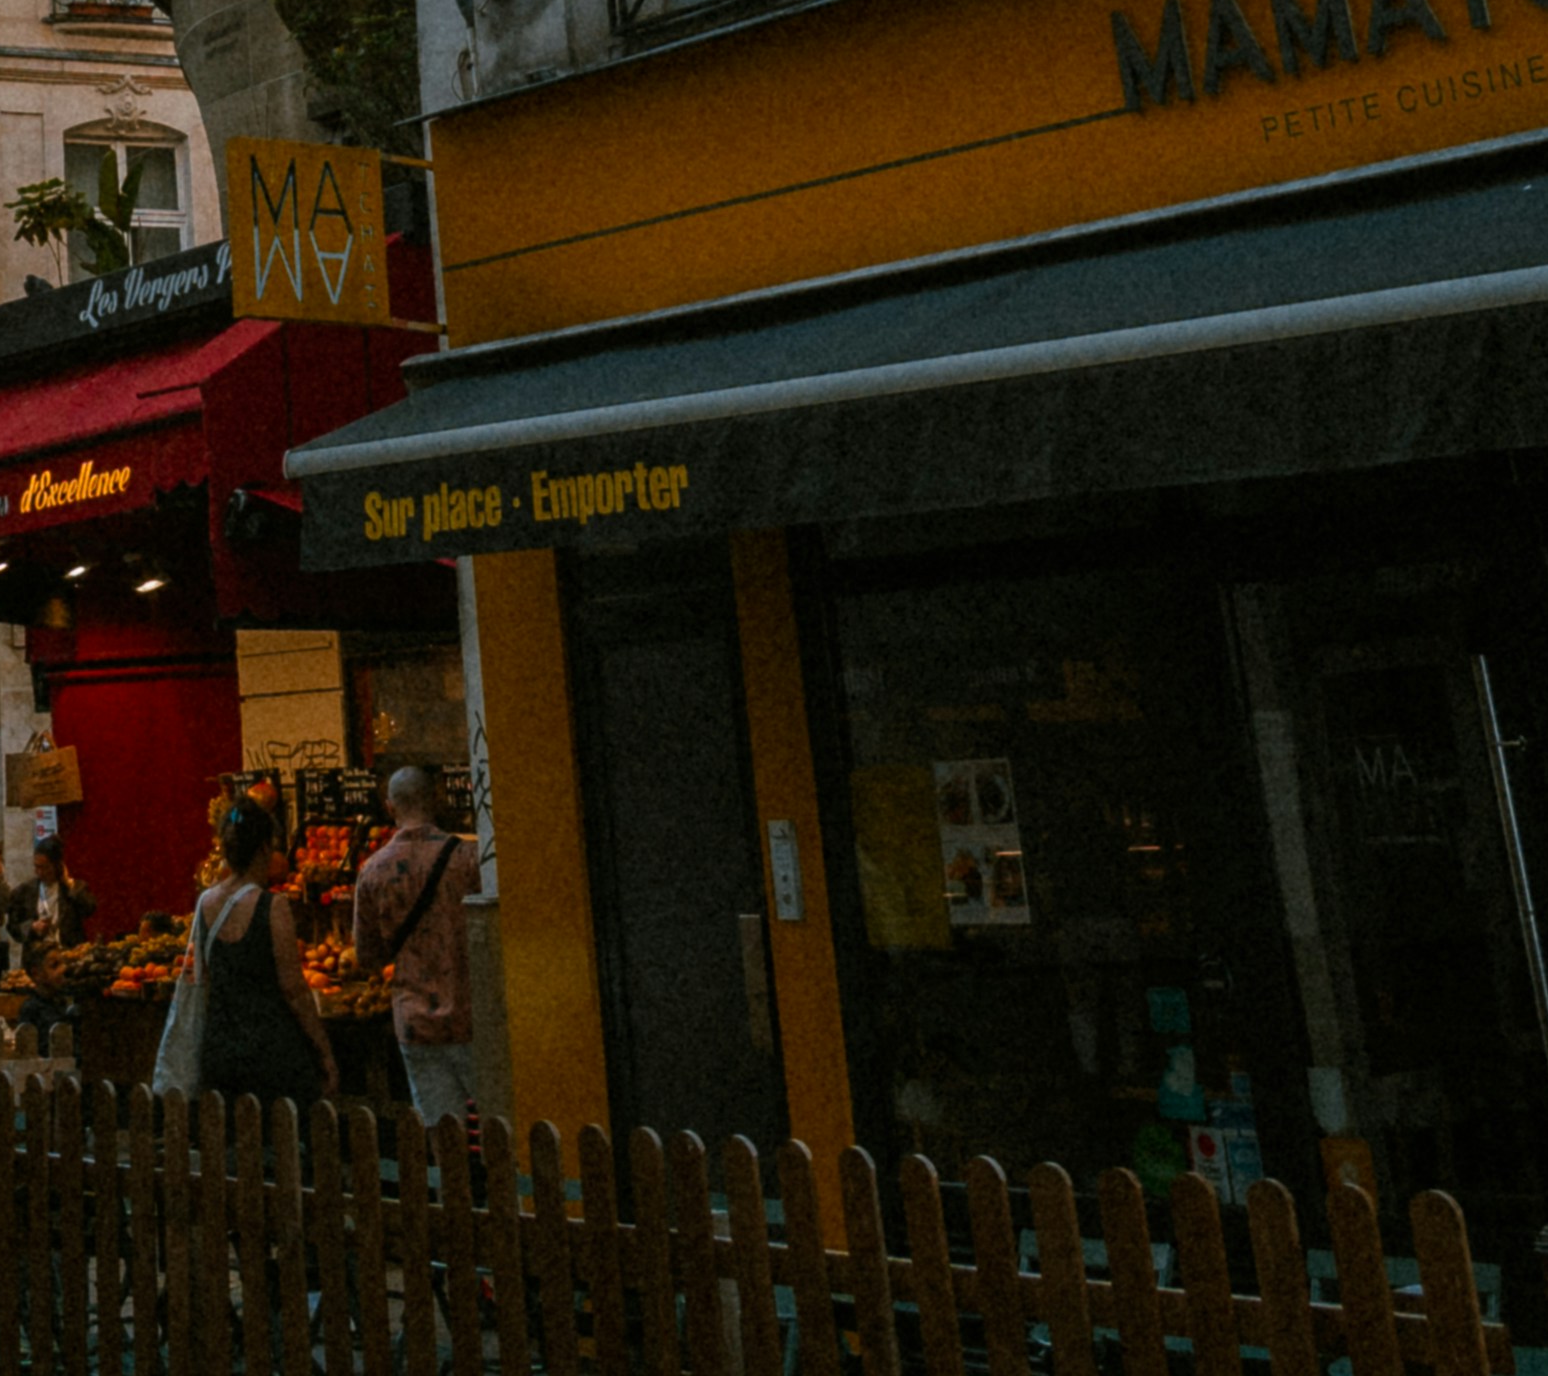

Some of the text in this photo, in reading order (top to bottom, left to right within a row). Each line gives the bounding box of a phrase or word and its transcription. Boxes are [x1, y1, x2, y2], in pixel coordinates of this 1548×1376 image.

[1260, 90, 1381, 142] PETITE
[78, 277, 118, 328] Les
[123, 265, 209, 311] Vergers
[19, 459, 132, 514] d'Excellence
[364, 460, 689, 542] Sur place Emporter
